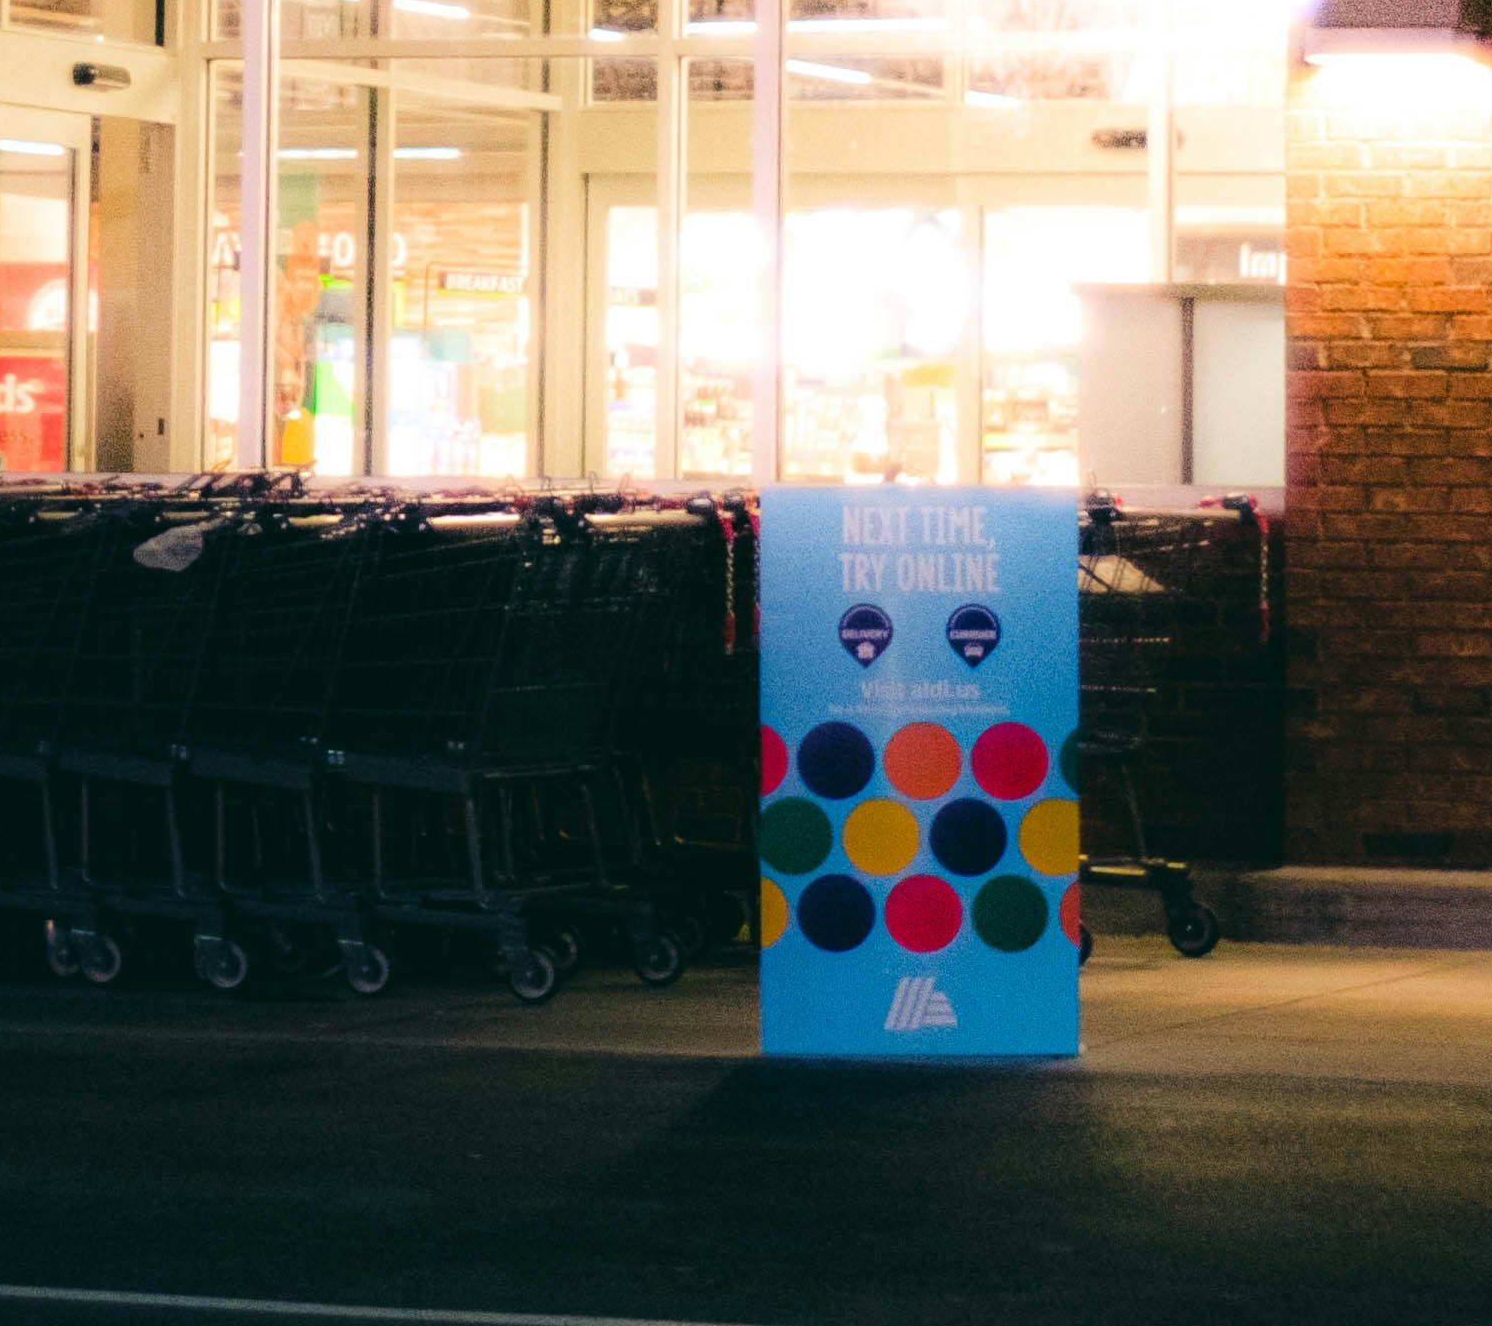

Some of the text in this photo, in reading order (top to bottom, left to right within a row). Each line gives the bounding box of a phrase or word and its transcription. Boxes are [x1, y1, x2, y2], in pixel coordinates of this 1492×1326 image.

[444, 274, 525, 293] BREAKFAST
[841, 505, 996, 550] NEXT TIME,
[839, 552, 1001, 594] TRY ONLINE
